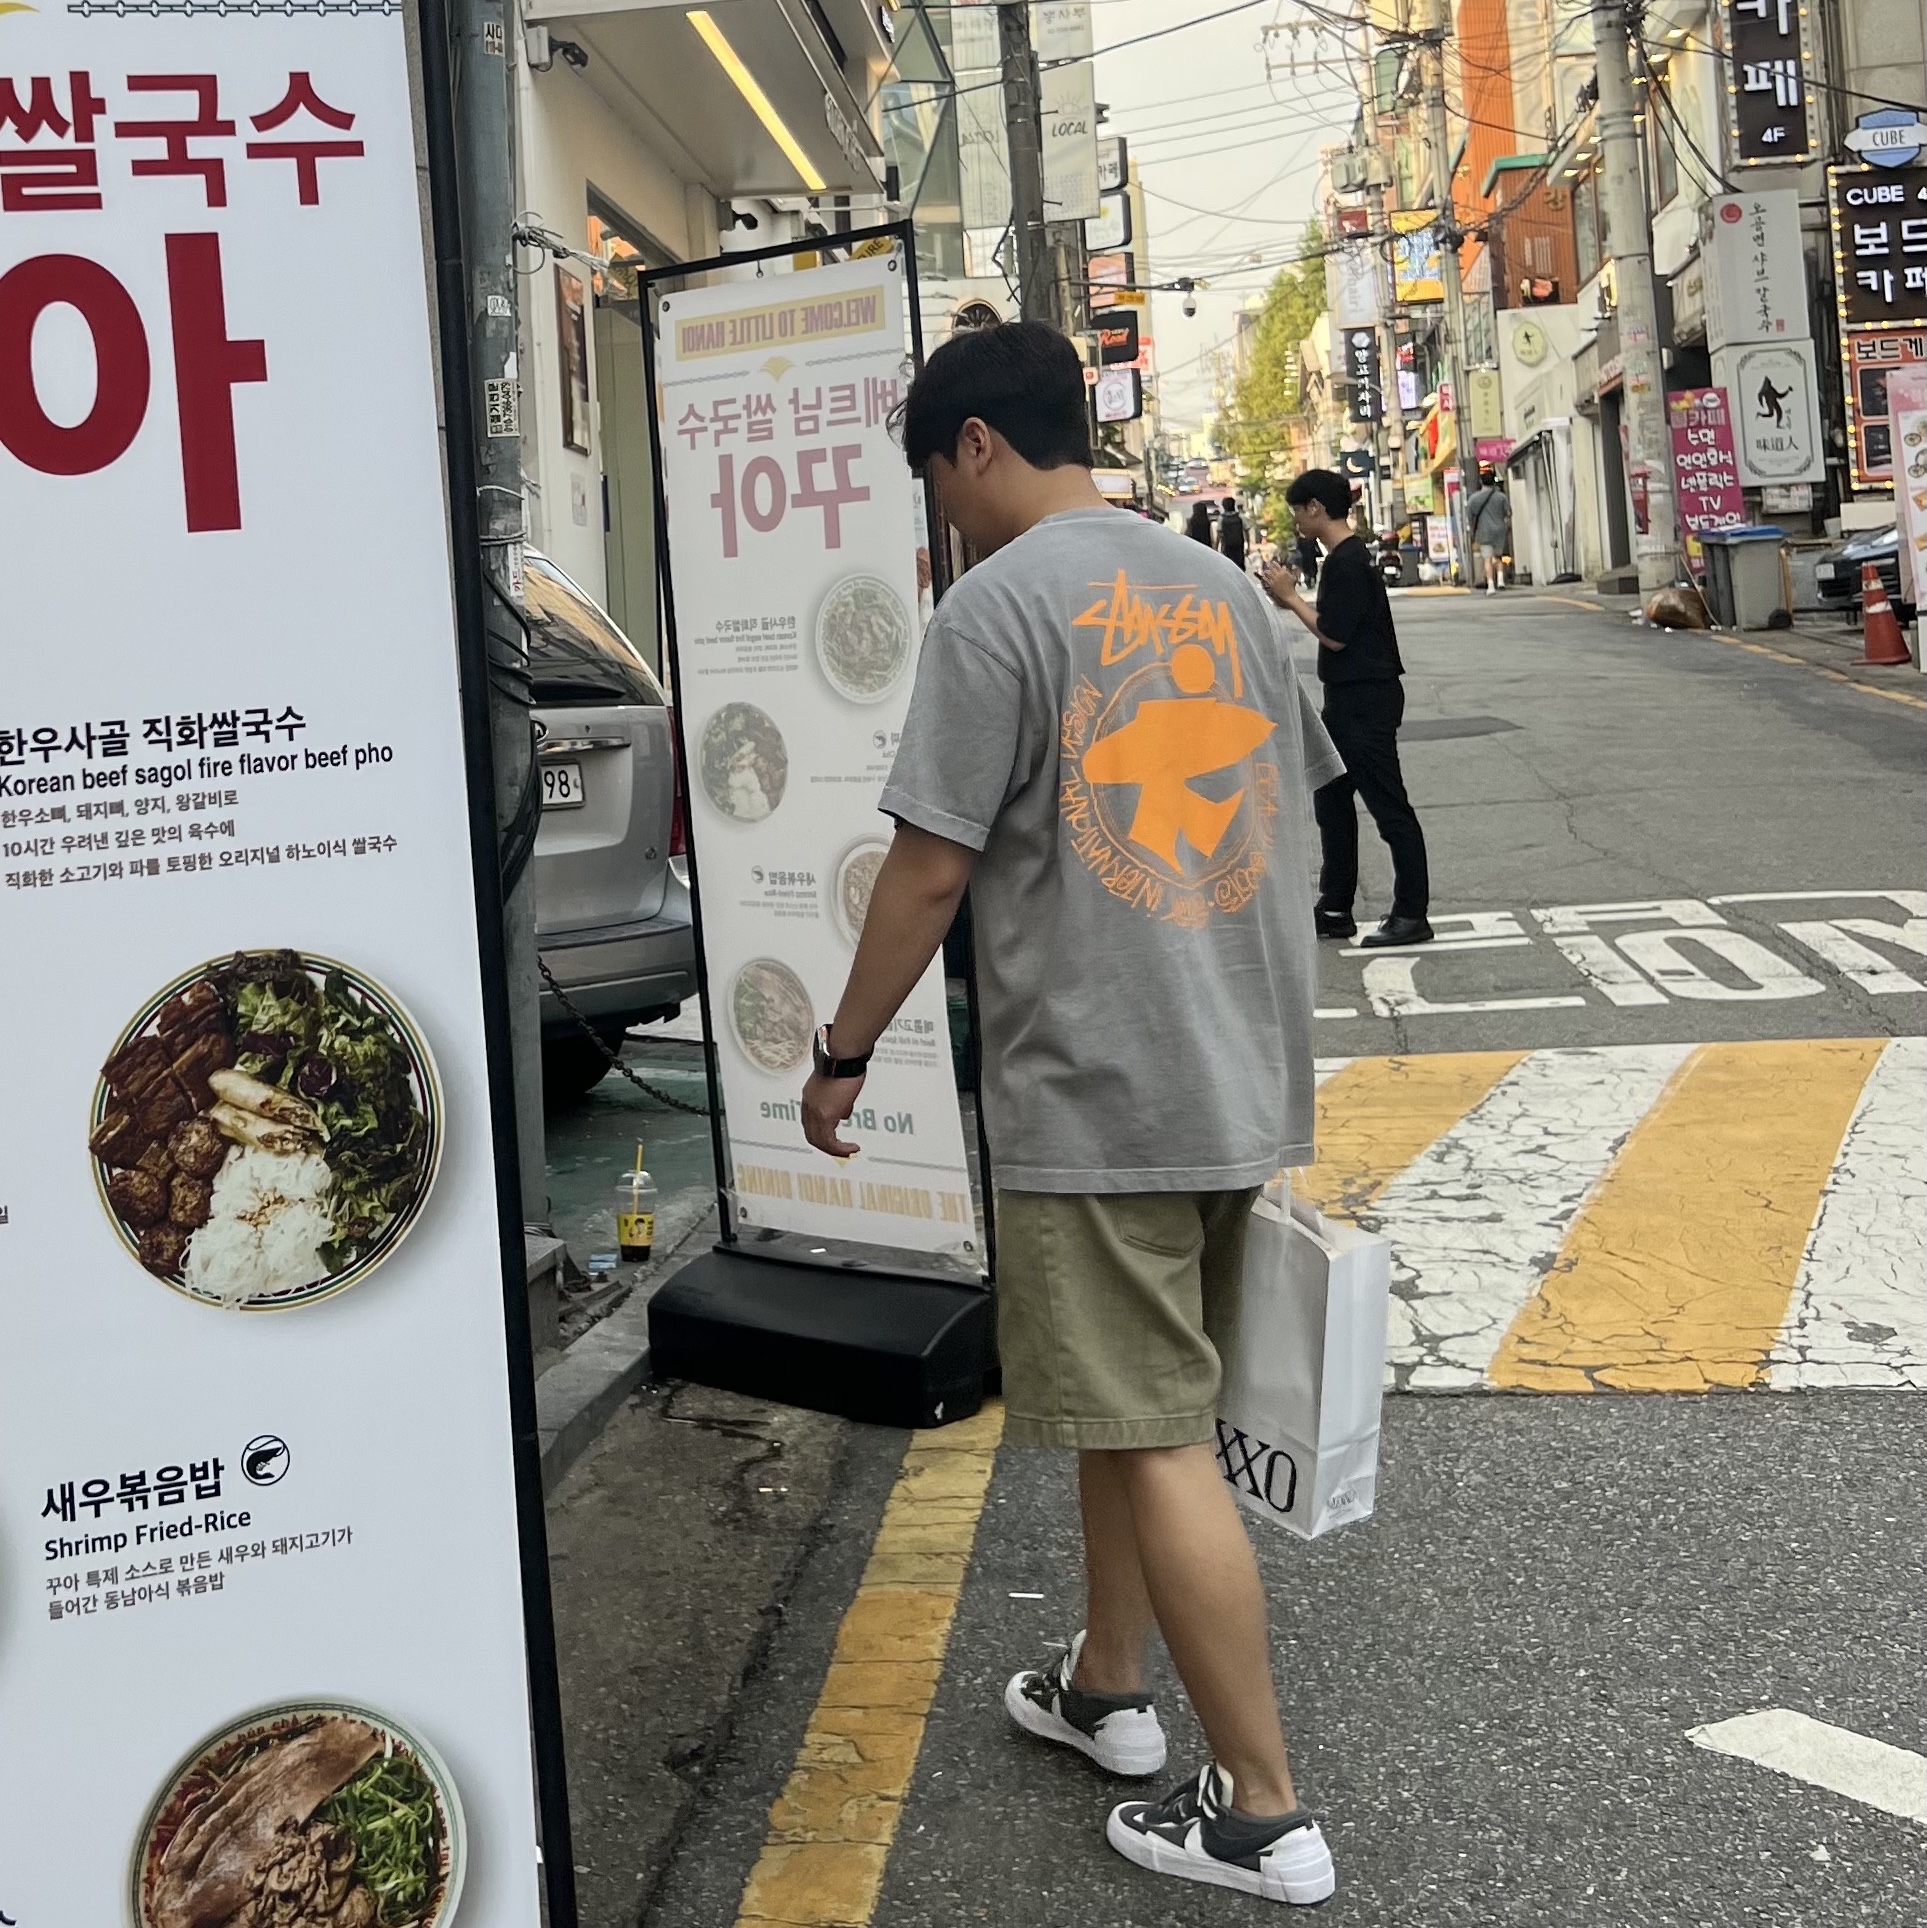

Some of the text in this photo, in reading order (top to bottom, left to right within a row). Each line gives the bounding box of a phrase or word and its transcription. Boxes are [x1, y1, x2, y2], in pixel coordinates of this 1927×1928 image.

[0, 71, 364, 212] 쌀국수
[1052, 122, 1088, 138] LOCAL
[1761, 127, 1786, 143] 4F
[1873, 130, 1905, 146] CUBE
[1846, 185, 1904, 205] CUBE
[0, 232, 267, 533] 아
[1699, 496, 1721, 511] TV
[0, 706, 307, 766] 한우사골 직화쌀국수
[0, 742, 393, 797] Korean beef sagol fire flavor beef pho
[544, 770, 570, 799] 98
[135, 796, 171, 816] 양지,
[176, 789, 239, 812] 왕갈비로
[2, 819, 236, 858] 10시간 우려낸 깊은 맛의 육수에
[6, 835, 398, 890] 직화한 소고기와 파를 토핑한 오리지널 하노이식 쌀국수
[1313, 890, 1927, 1018] 진입금
[41, 1457, 225, 1522] 새우볶음밥
[45, 1508, 252, 1561] Shrimp Fried-Rice
[46, 1526, 353, 1597] 꾸아 특제 소스로 만든 새우와 돼지고기가
[48, 1571, 225, 1620] 들어간 동남아식 볶음밥
